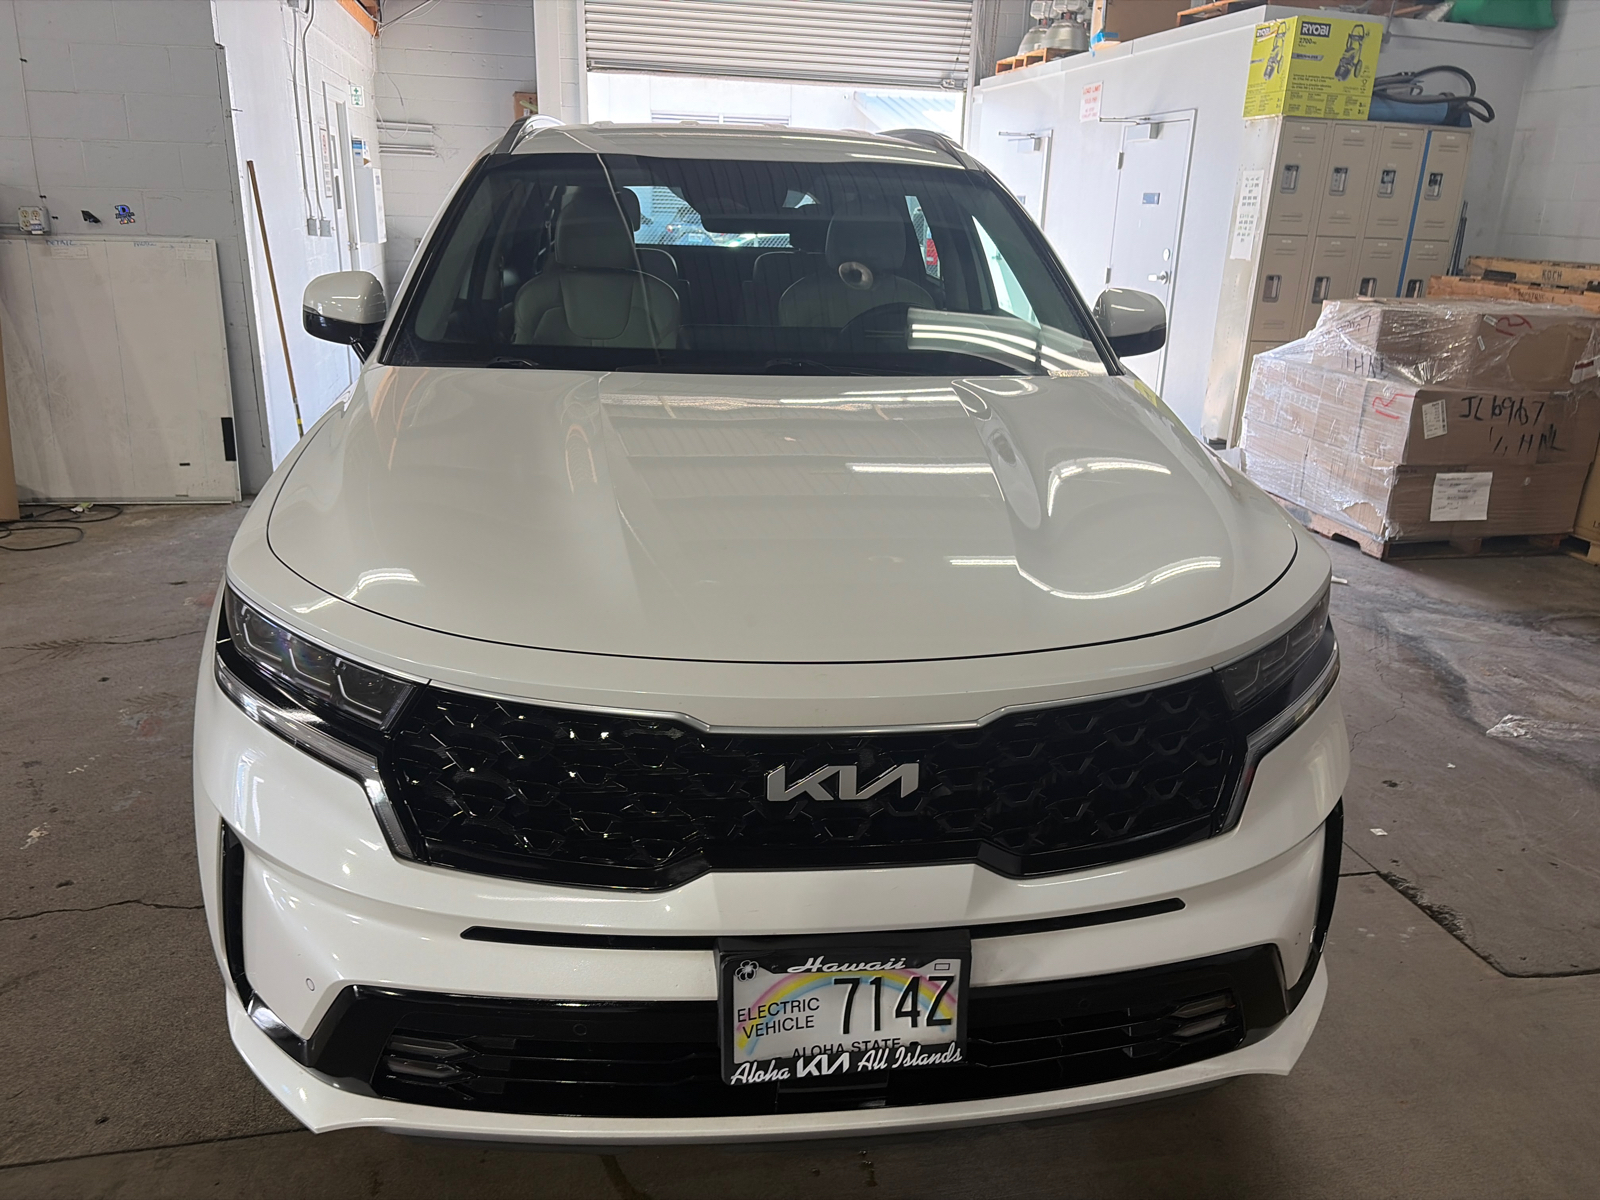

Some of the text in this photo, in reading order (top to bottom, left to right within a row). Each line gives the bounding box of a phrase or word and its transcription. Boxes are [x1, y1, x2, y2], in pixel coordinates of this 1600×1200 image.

[1301, 23, 1330, 36] RYOBI
[1542, 269, 1563, 281] KOCH
[787, 956, 907, 973] Hawaii
[737, 997, 820, 1023] ELECTRIC
[742, 1015, 815, 1039] VEHICLE
[792, 1038, 901, 1058] ALOHA STATE
[730, 1060, 791, 1085] Aloha
[857, 1047, 888, 1072] All
[891, 1042, 963, 1069] Islands
